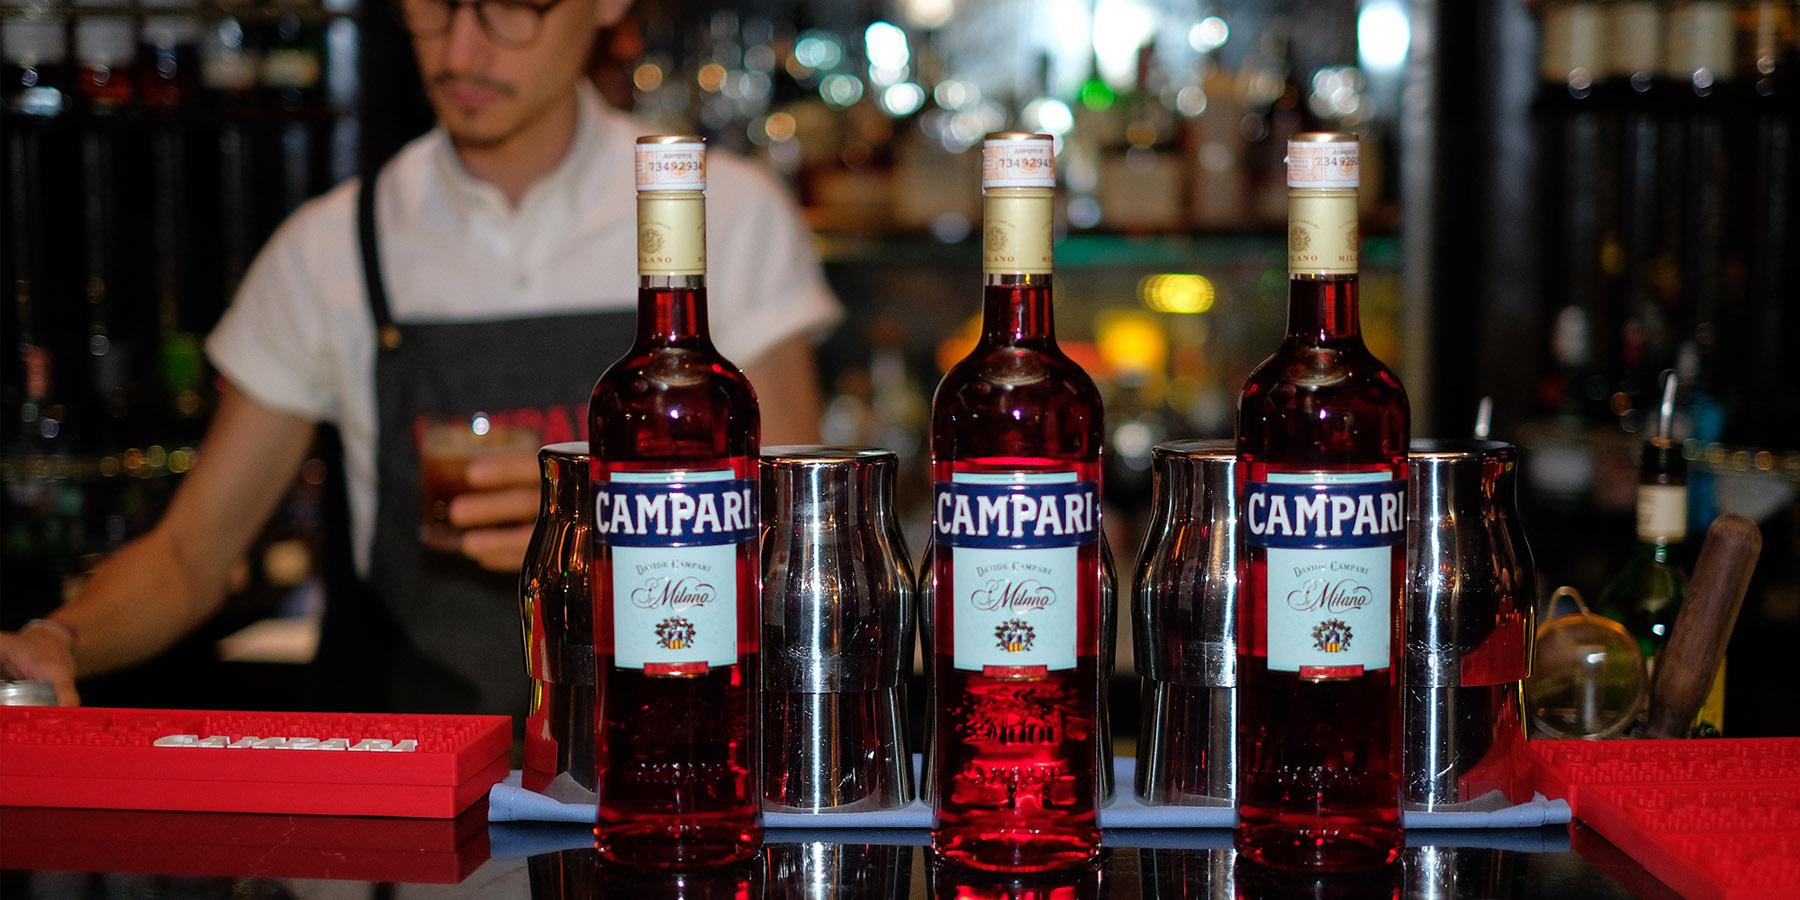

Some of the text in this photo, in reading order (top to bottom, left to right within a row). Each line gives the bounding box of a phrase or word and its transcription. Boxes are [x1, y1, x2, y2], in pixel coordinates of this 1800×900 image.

[595, 488, 751, 536] CAMPARI
[937, 491, 1094, 538] CAMPARI
[1248, 490, 1405, 538] CAMPARI
[1330, 560, 1369, 575] CAMPARI
[631, 576, 717, 610] Milano
[971, 579, 1057, 613] Milano
[1287, 579, 1373, 614] Milano
